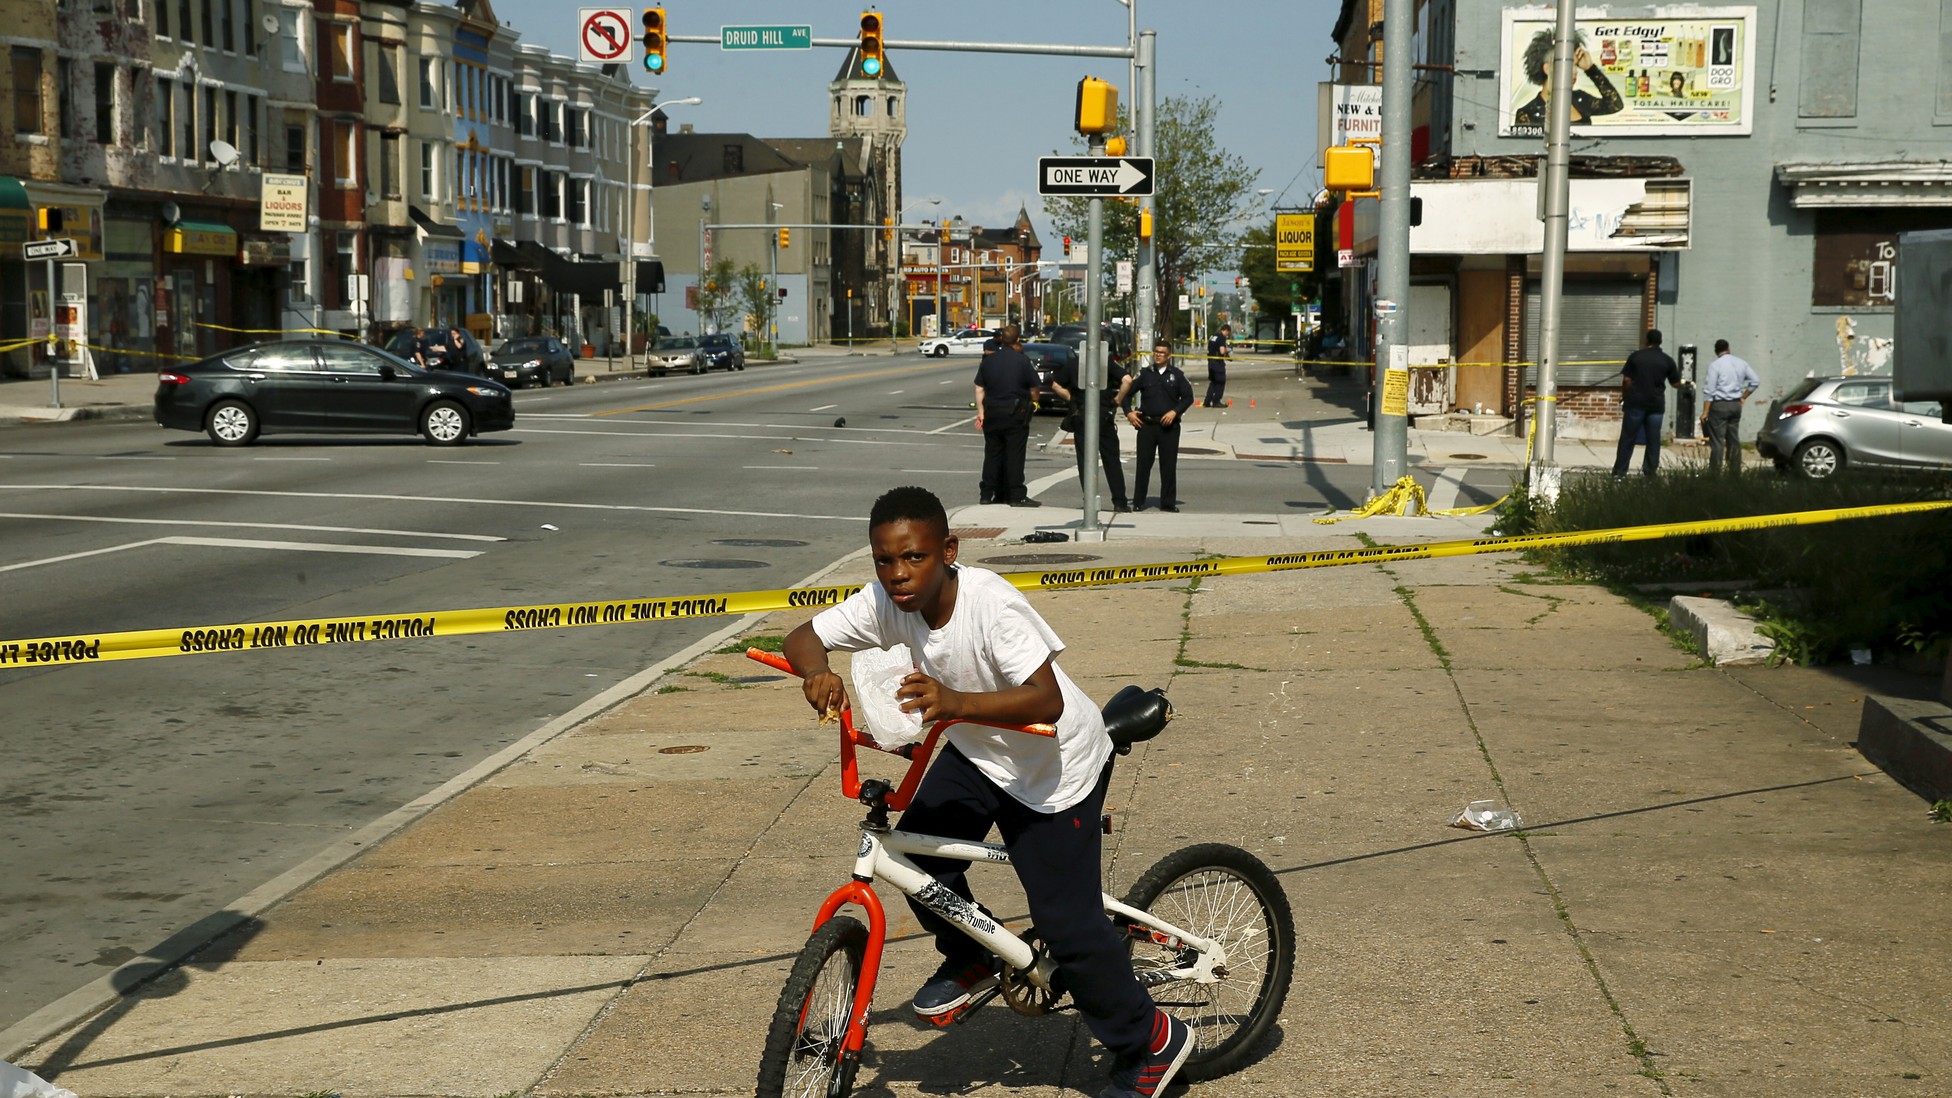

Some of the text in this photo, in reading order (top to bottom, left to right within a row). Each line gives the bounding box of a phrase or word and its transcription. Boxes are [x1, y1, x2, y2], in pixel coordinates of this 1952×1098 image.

[726, 28, 807, 45] DRUID HILL AVE
[1595, 26, 1665, 38] Get Edgy!
[1710, 68, 1733, 77] DOO
[1710, 76, 1731, 85] GRO
[1337, 103, 1361, 115] NEW
[1364, 105, 1374, 115] &
[1337, 118, 1380, 132] FURNIT
[1053, 169, 1118, 183] ONE WAY
[265, 201, 302, 210] LIQUORS
[1279, 231, 1312, 244] LIQUOR
[30, 247, 42, 255] ONE
[603, 604, 626, 622] DO
[631, 602, 666, 620] LINE
[670, 598, 727, 616] POLICE
[504, 607, 561, 630] CROSS
[180, 617, 436, 652] POLICE LINE DO NOT CROSS
[0, 638, 100, 664] POLICE LI
